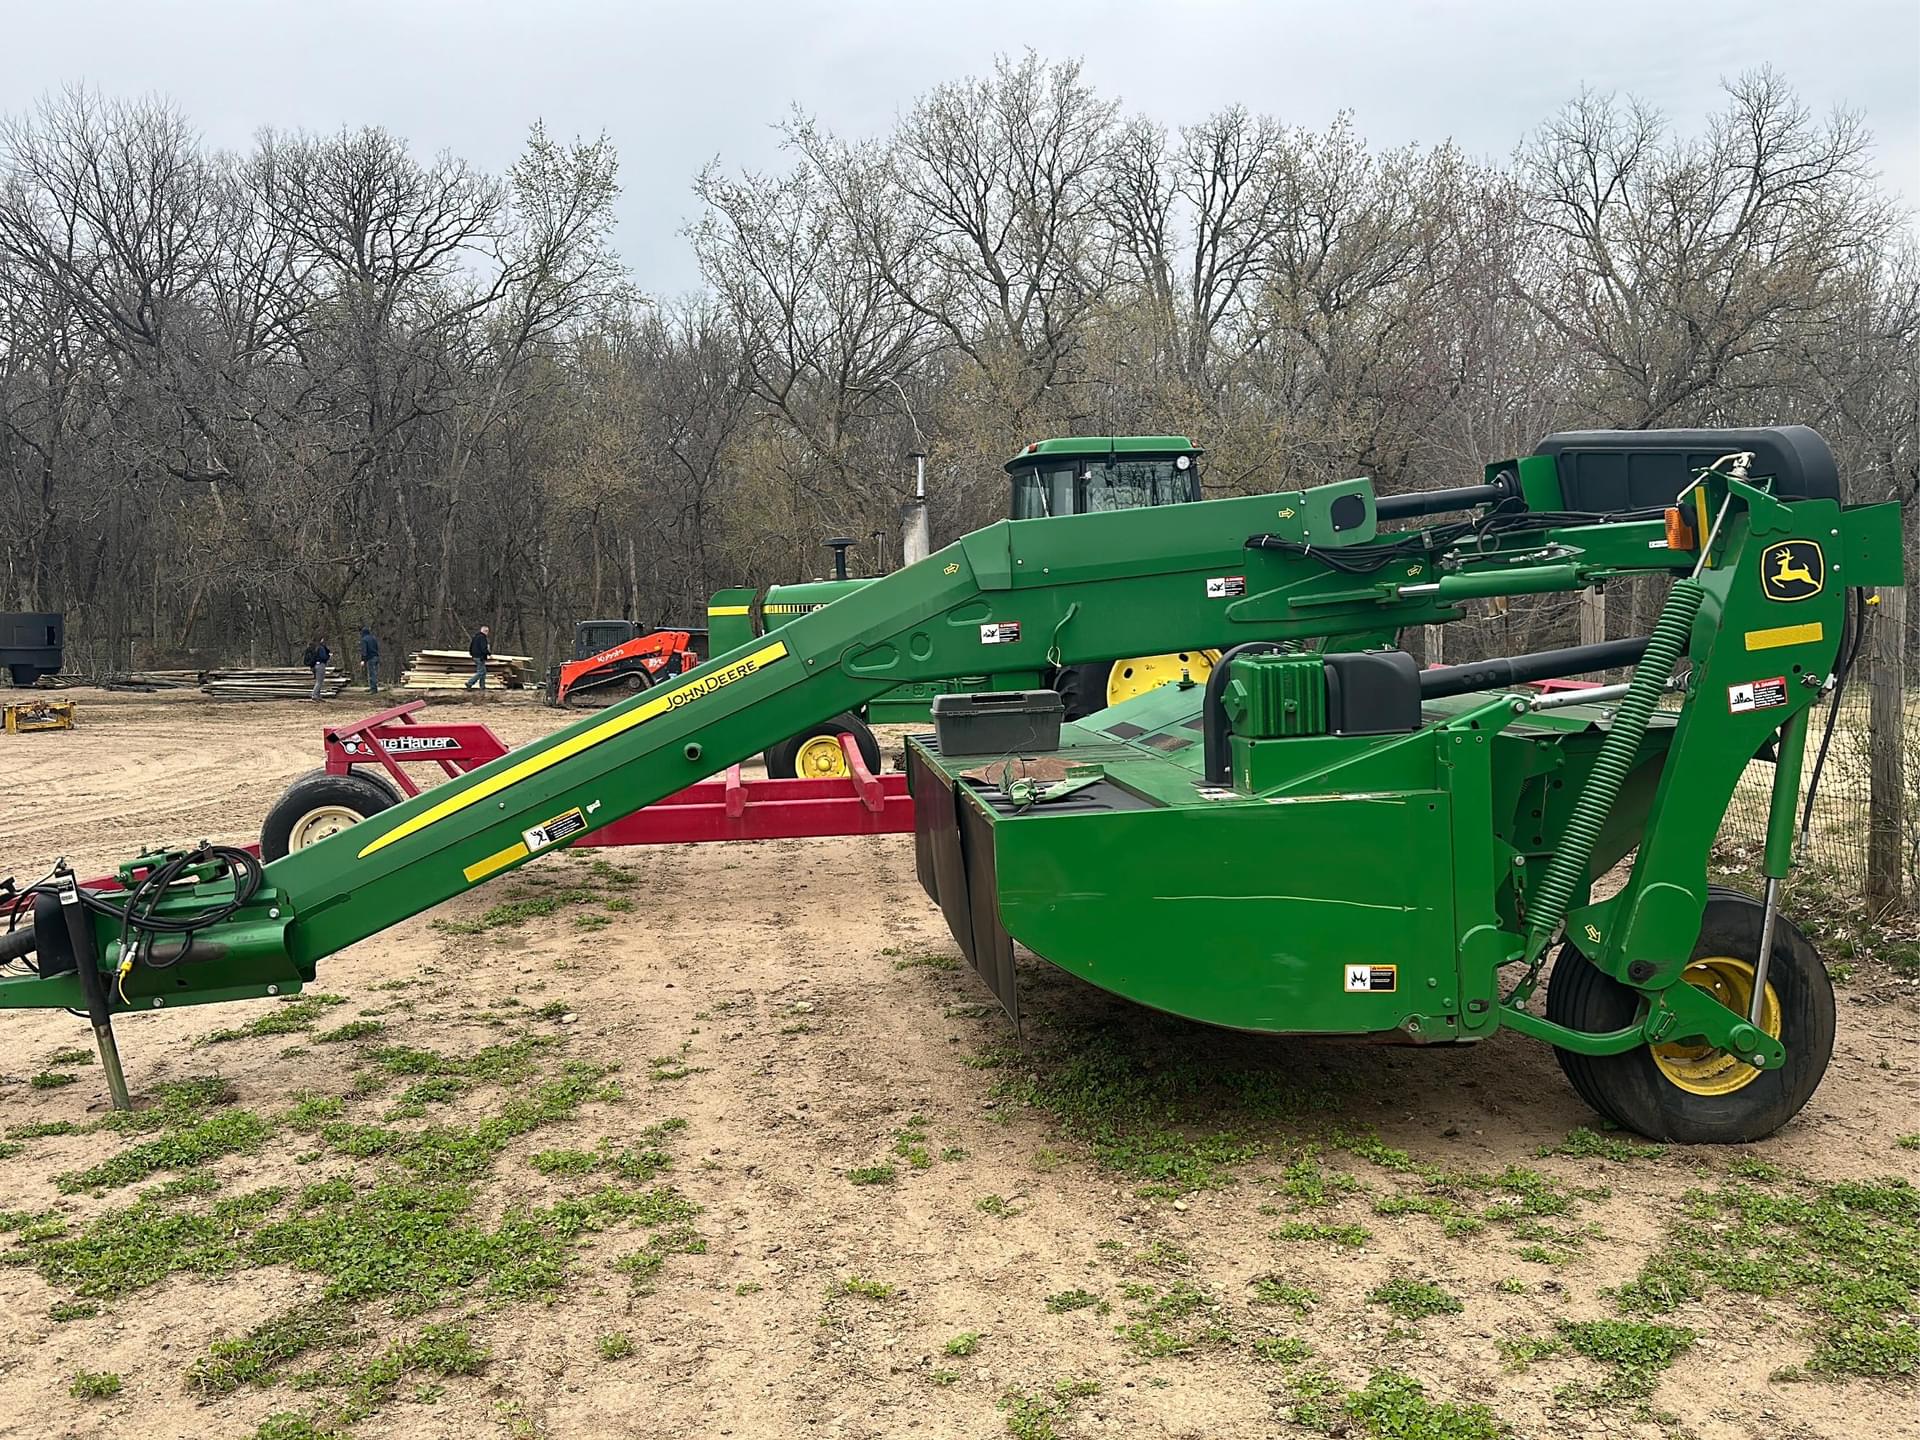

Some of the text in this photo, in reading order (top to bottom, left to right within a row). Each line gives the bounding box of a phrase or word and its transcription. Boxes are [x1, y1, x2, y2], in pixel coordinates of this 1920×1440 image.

[666, 660, 757, 710] JOHN DEERE
[400, 736, 449, 749] Hauler
